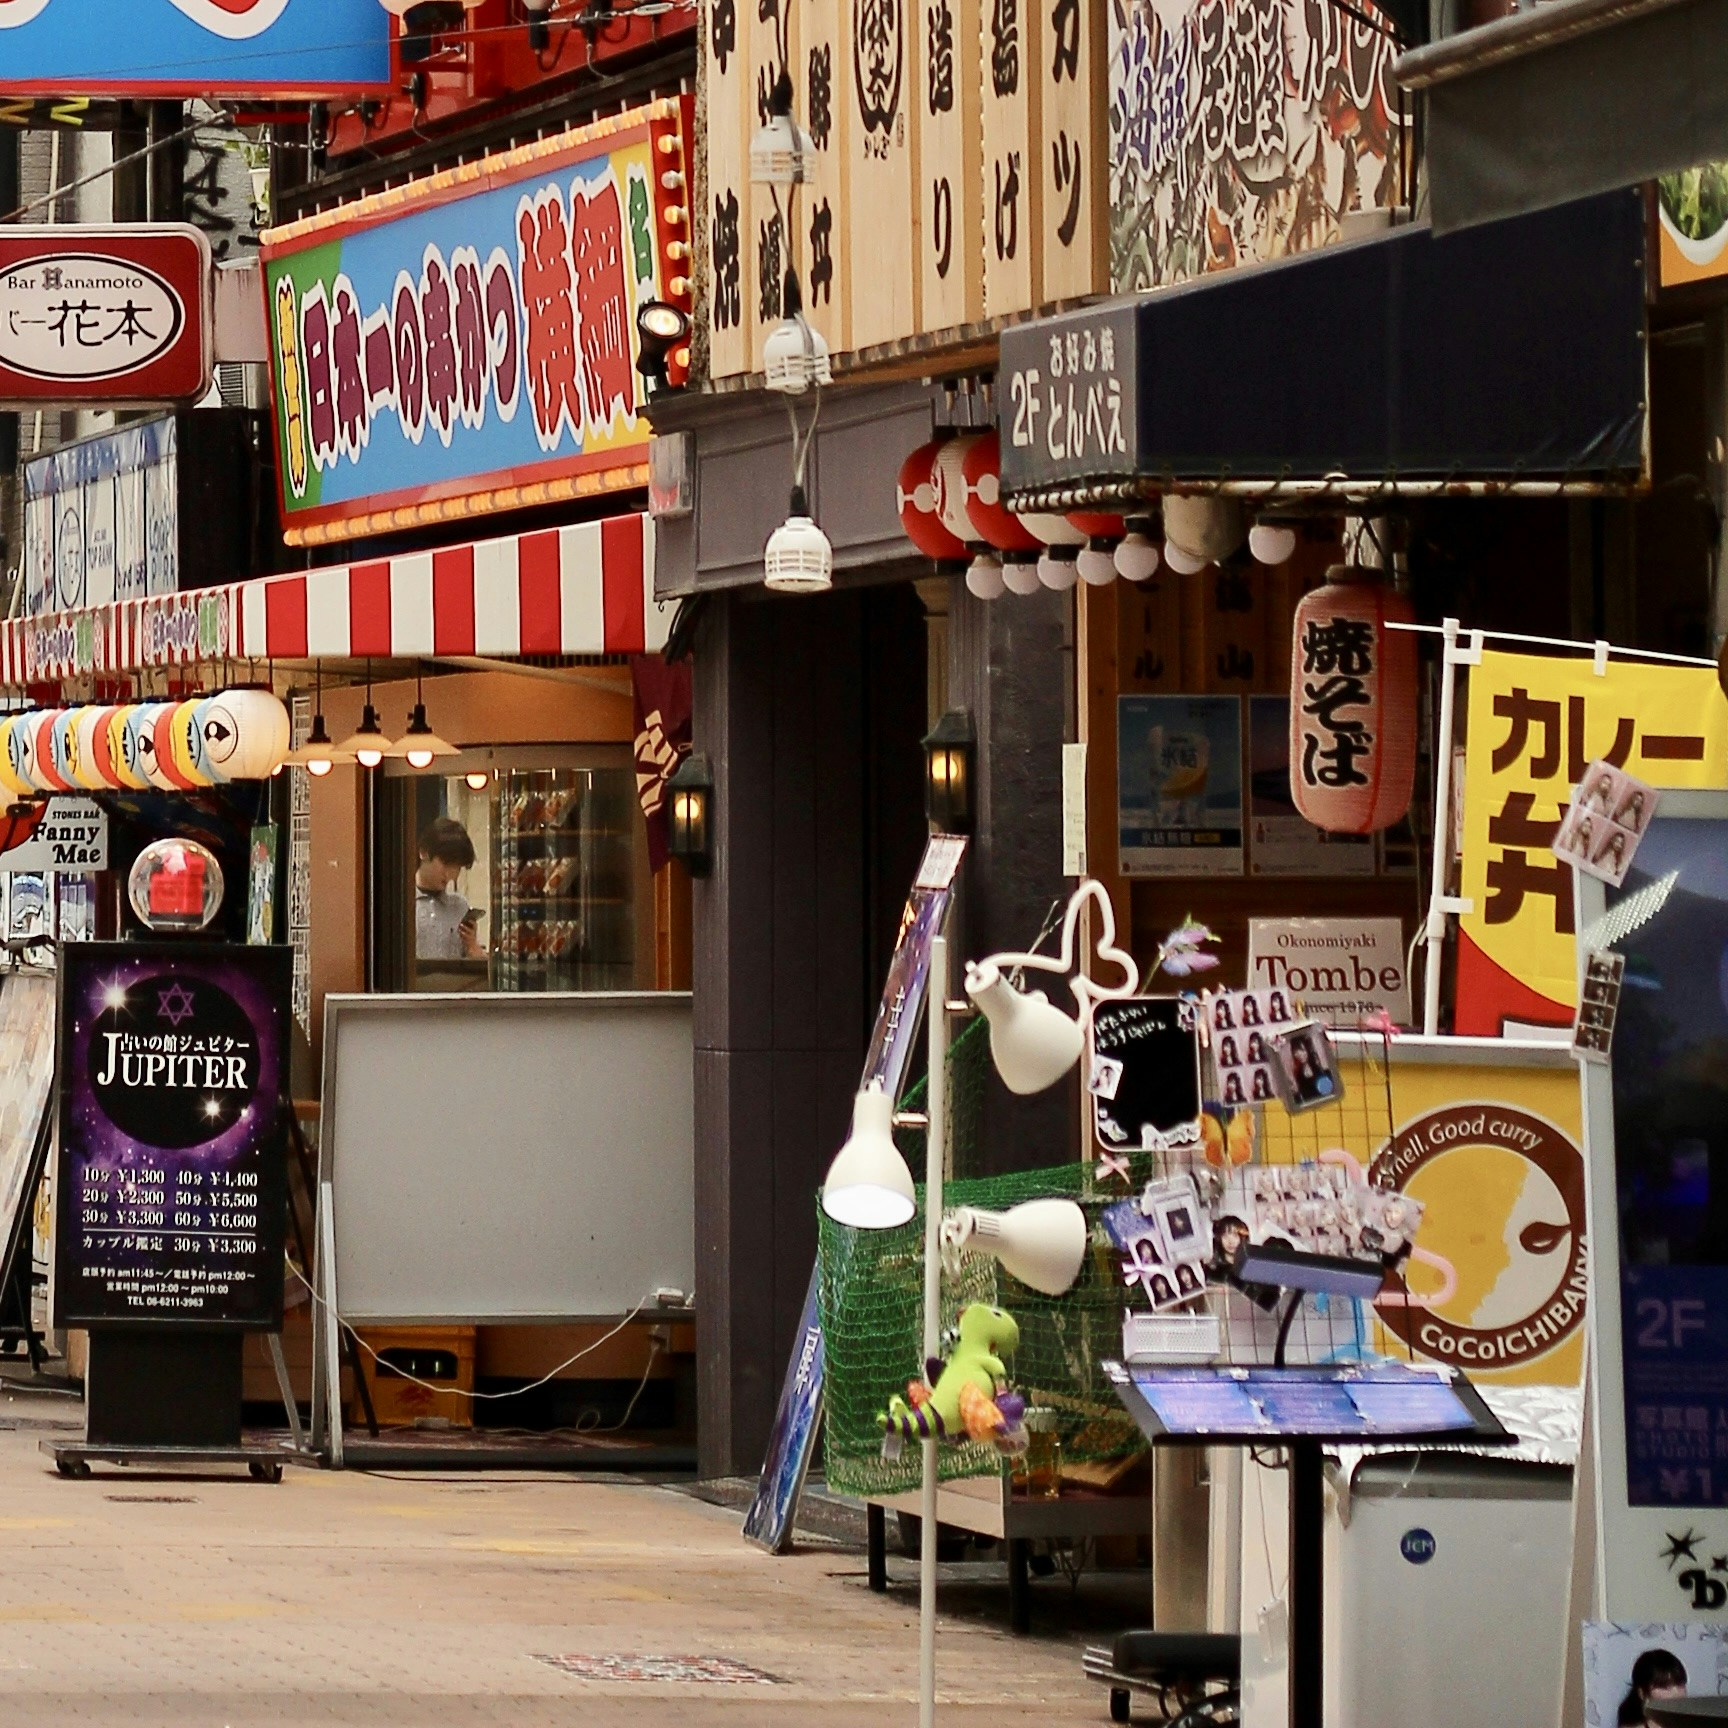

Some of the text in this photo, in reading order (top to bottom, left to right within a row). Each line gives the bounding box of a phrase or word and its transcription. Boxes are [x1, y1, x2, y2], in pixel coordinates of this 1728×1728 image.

[8, 267, 144, 291] Bar Hanamoto
[303, 258, 518, 454] 日本一の串かつ
[1049, 325, 1115, 378] お好み焼
[1010, 368, 1041, 447] 2F
[1047, 376, 1127, 461] とんべえ
[1302, 617, 1373, 788] 焼そば
[1491, 686, 1706, 784] カレー
[30, 822, 101, 845] Fanny
[52, 843, 101, 864] Mae
[1277, 932, 1377, 950] Okonomiyaki
[1256, 955, 1402, 993] Tombe
[96, 1032, 249, 1090] JUPITER
[1428, 1113, 1487, 1145] Good
[1488, 1119, 1544, 1151] curry
[116, 1189, 165, 1206] ¥2,300
[209, 1192, 258, 1208] ¥5,500
[116, 1210, 164, 1226] ¥3,300
[209, 1213, 257, 1229] ¥6,600
[208, 1238, 257, 1255] ¥3,300
[127, 1296, 145, 1307] TEL
